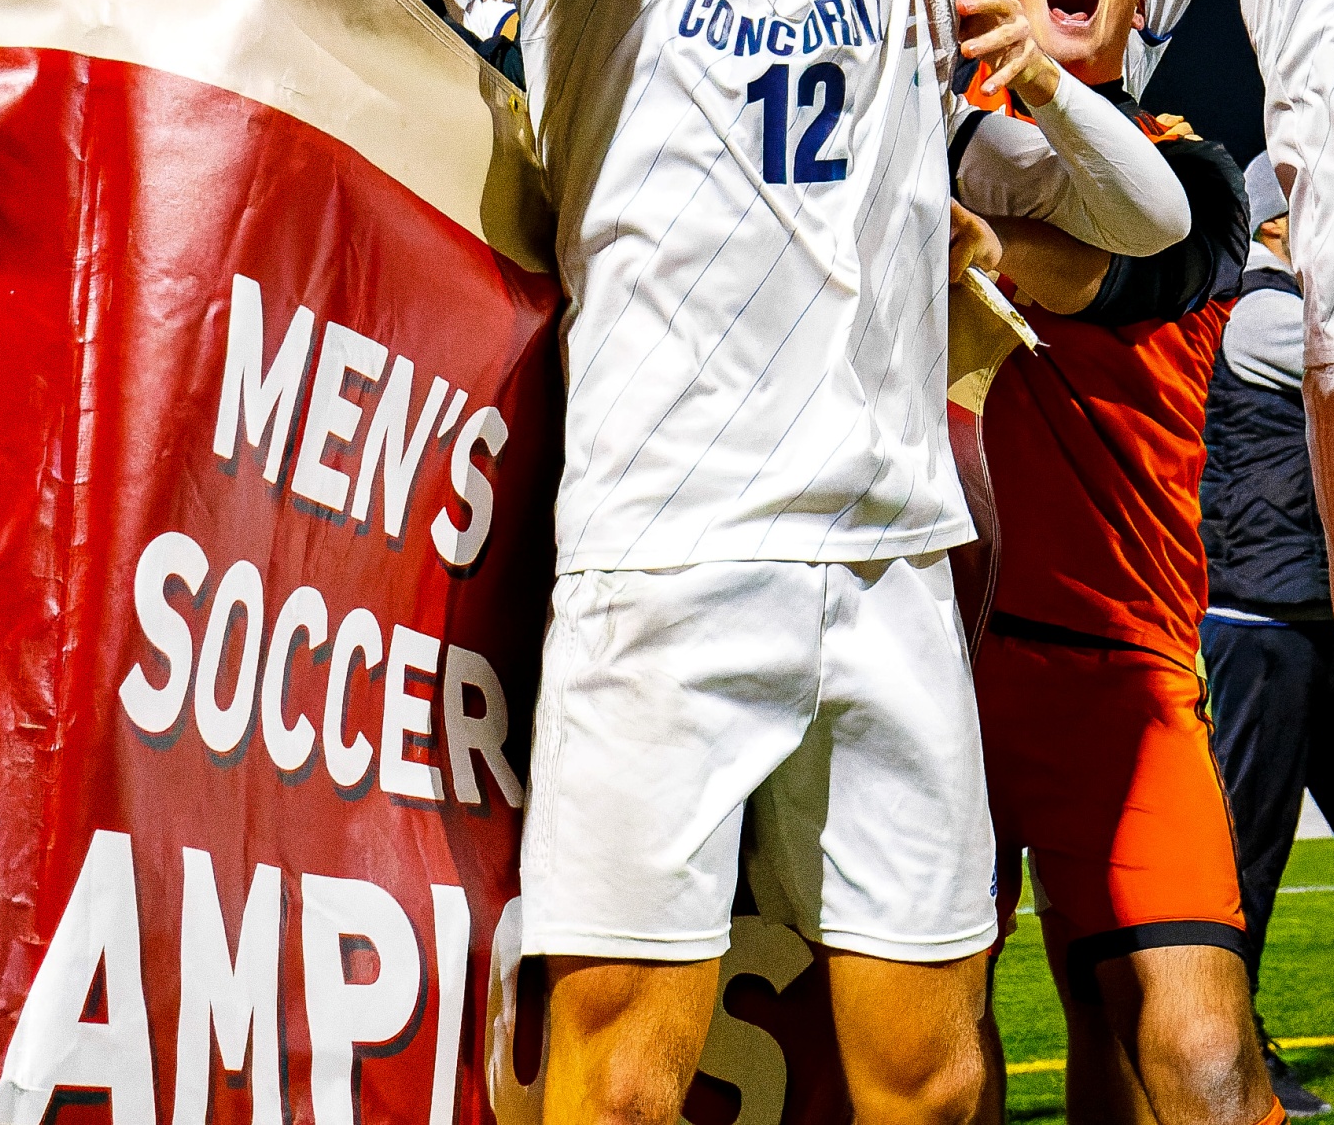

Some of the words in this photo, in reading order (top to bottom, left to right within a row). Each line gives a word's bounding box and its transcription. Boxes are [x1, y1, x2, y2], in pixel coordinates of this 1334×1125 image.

[746, 61, 849, 185] 12
[213, 273, 509, 568] MEN'S
[119, 531, 524, 810] SOCCER
